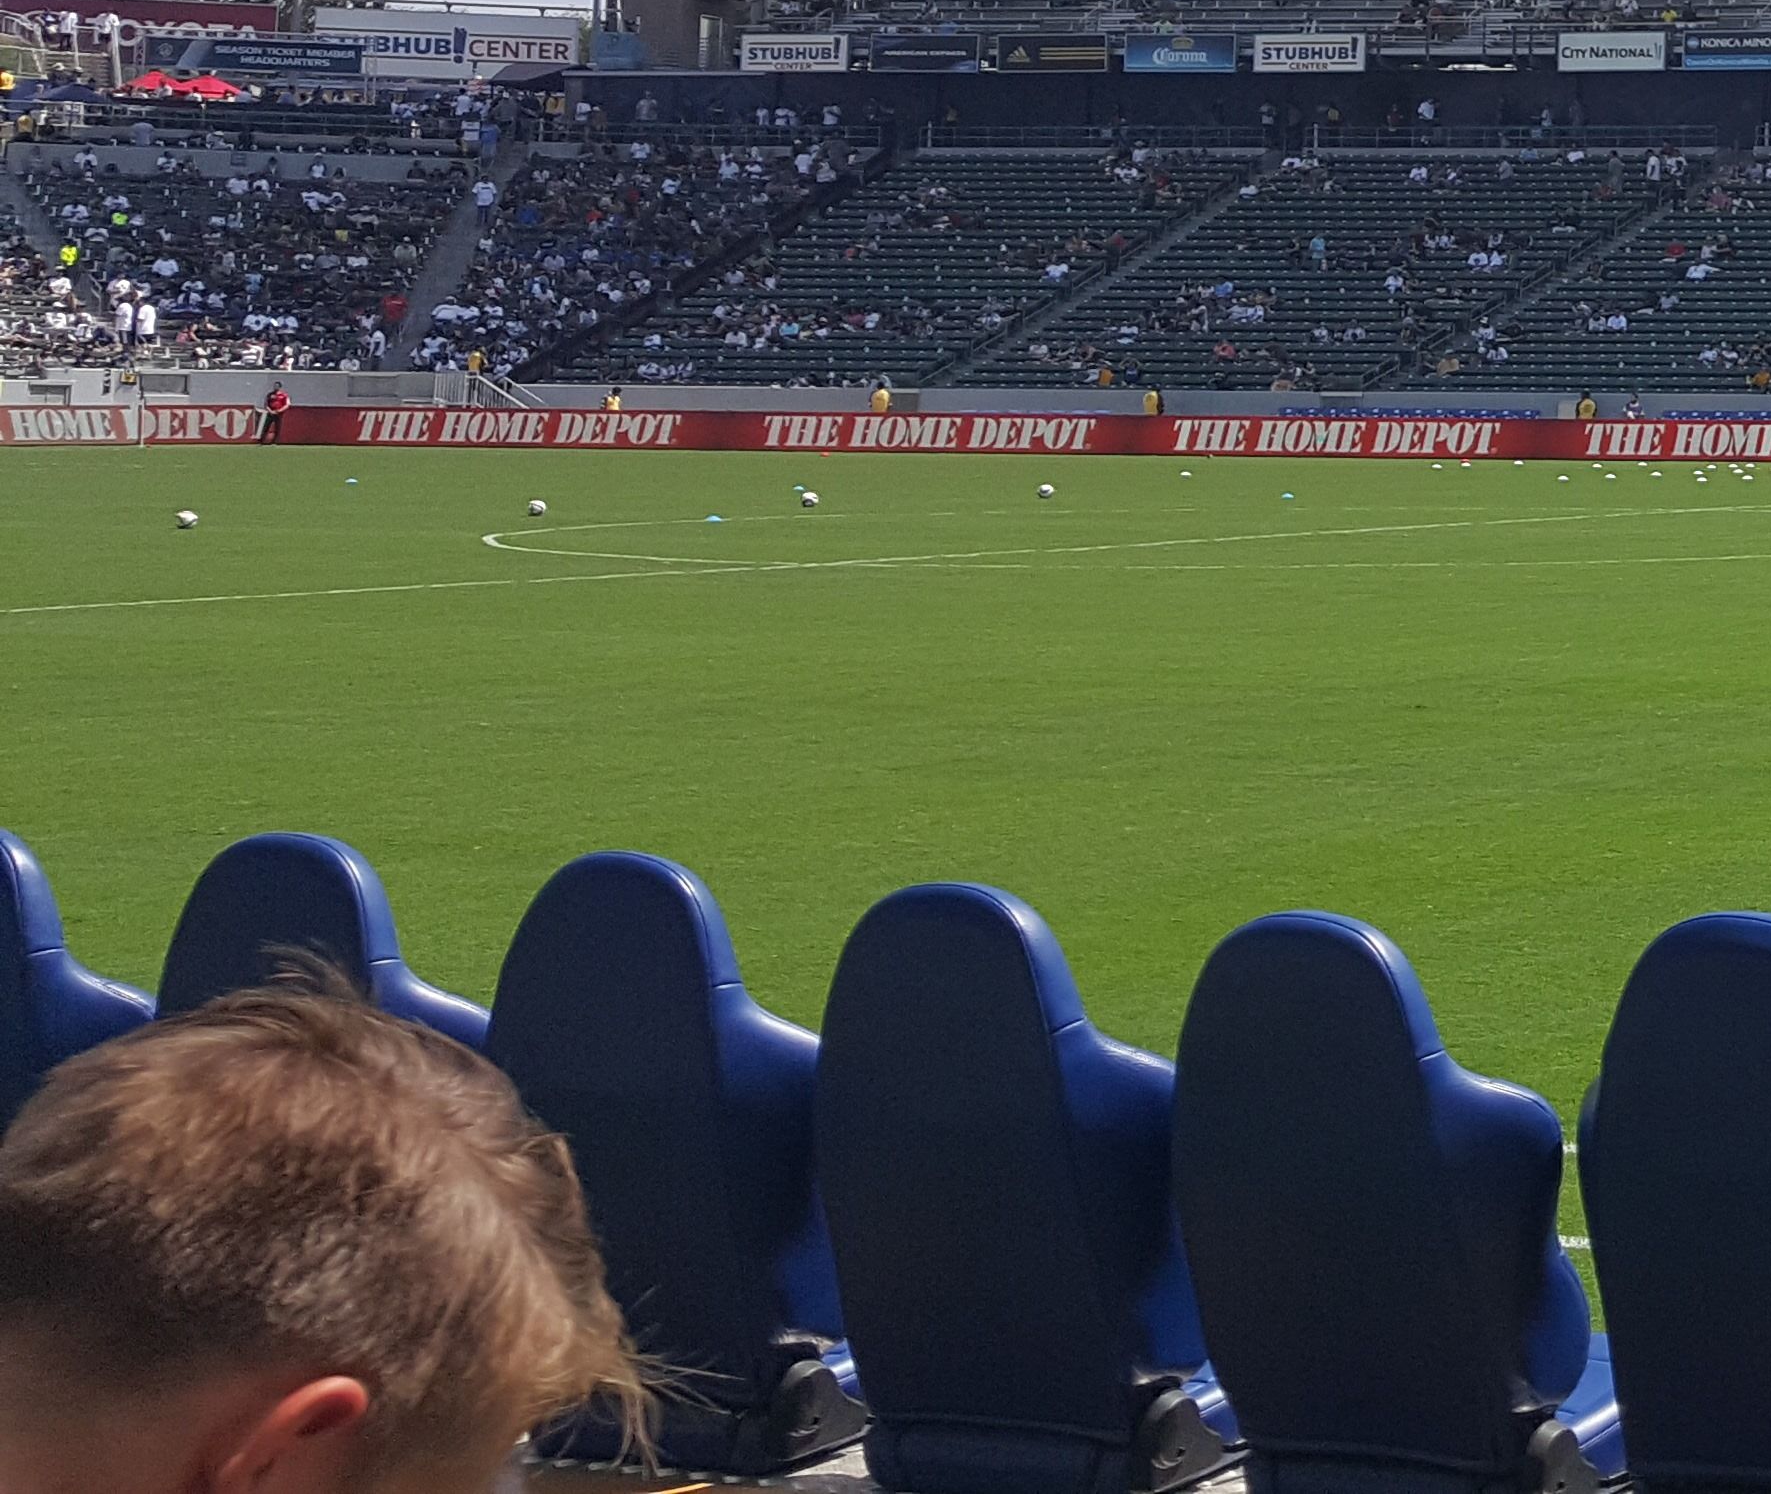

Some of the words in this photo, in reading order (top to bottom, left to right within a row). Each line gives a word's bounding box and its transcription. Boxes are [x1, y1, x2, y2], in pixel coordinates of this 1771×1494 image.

[214, 45, 262, 55] SEASON
[267, 47, 304, 57] TICKET
[307, 49, 355, 59] MEMBER
[469, 39, 569, 60] CENTER
[748, 37, 840, 60] STUBHUB!
[1261, 36, 1357, 60] STUBHUB!
[1700, 38, 1740, 48] KONICA
[240, 55, 330, 67] HEADQUARTERS
[774, 61, 811, 70] CENTER
[1152, 47, 1208, 65] Corona
[1289, 62, 1329, 70] CENTER
[8, 409, 117, 442] HOME
[358, 410, 434, 442] THE
[437, 410, 551, 443] HOME
[554, 412, 682, 445] DEPOT
[763, 414, 842, 446] THE
[847, 416, 962, 448] HOME
[967, 417, 1095, 450] DEPOT
[1173, 417, 1248, 450] THE
[1252, 418, 1371, 452] HOME
[1373, 420, 1500, 454] DEPOT
[1586, 423, 1666, 456] THE
